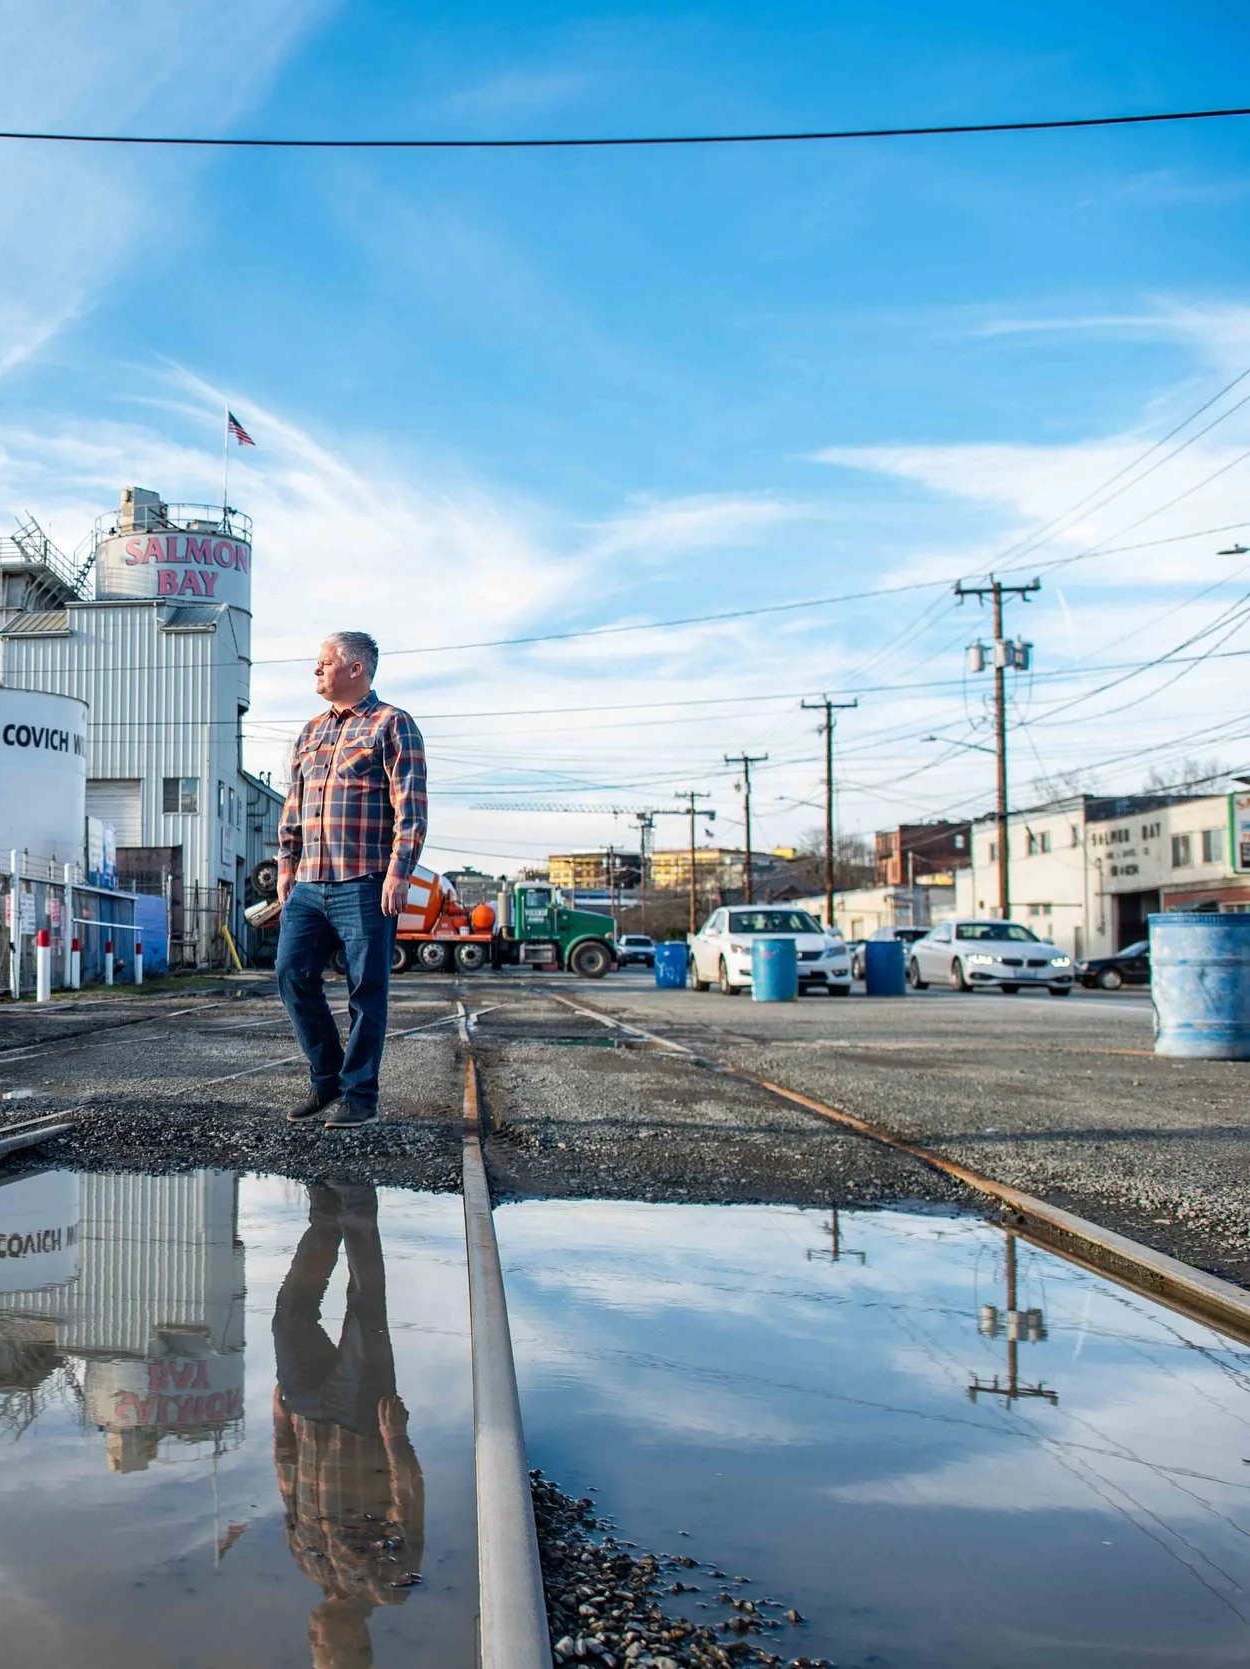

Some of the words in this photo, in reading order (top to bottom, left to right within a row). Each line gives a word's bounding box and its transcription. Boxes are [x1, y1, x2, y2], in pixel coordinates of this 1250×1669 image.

[125, 536, 249, 574] SALMON
[157, 569, 219, 598] BAY
[3, 724, 69, 753] COVICH
